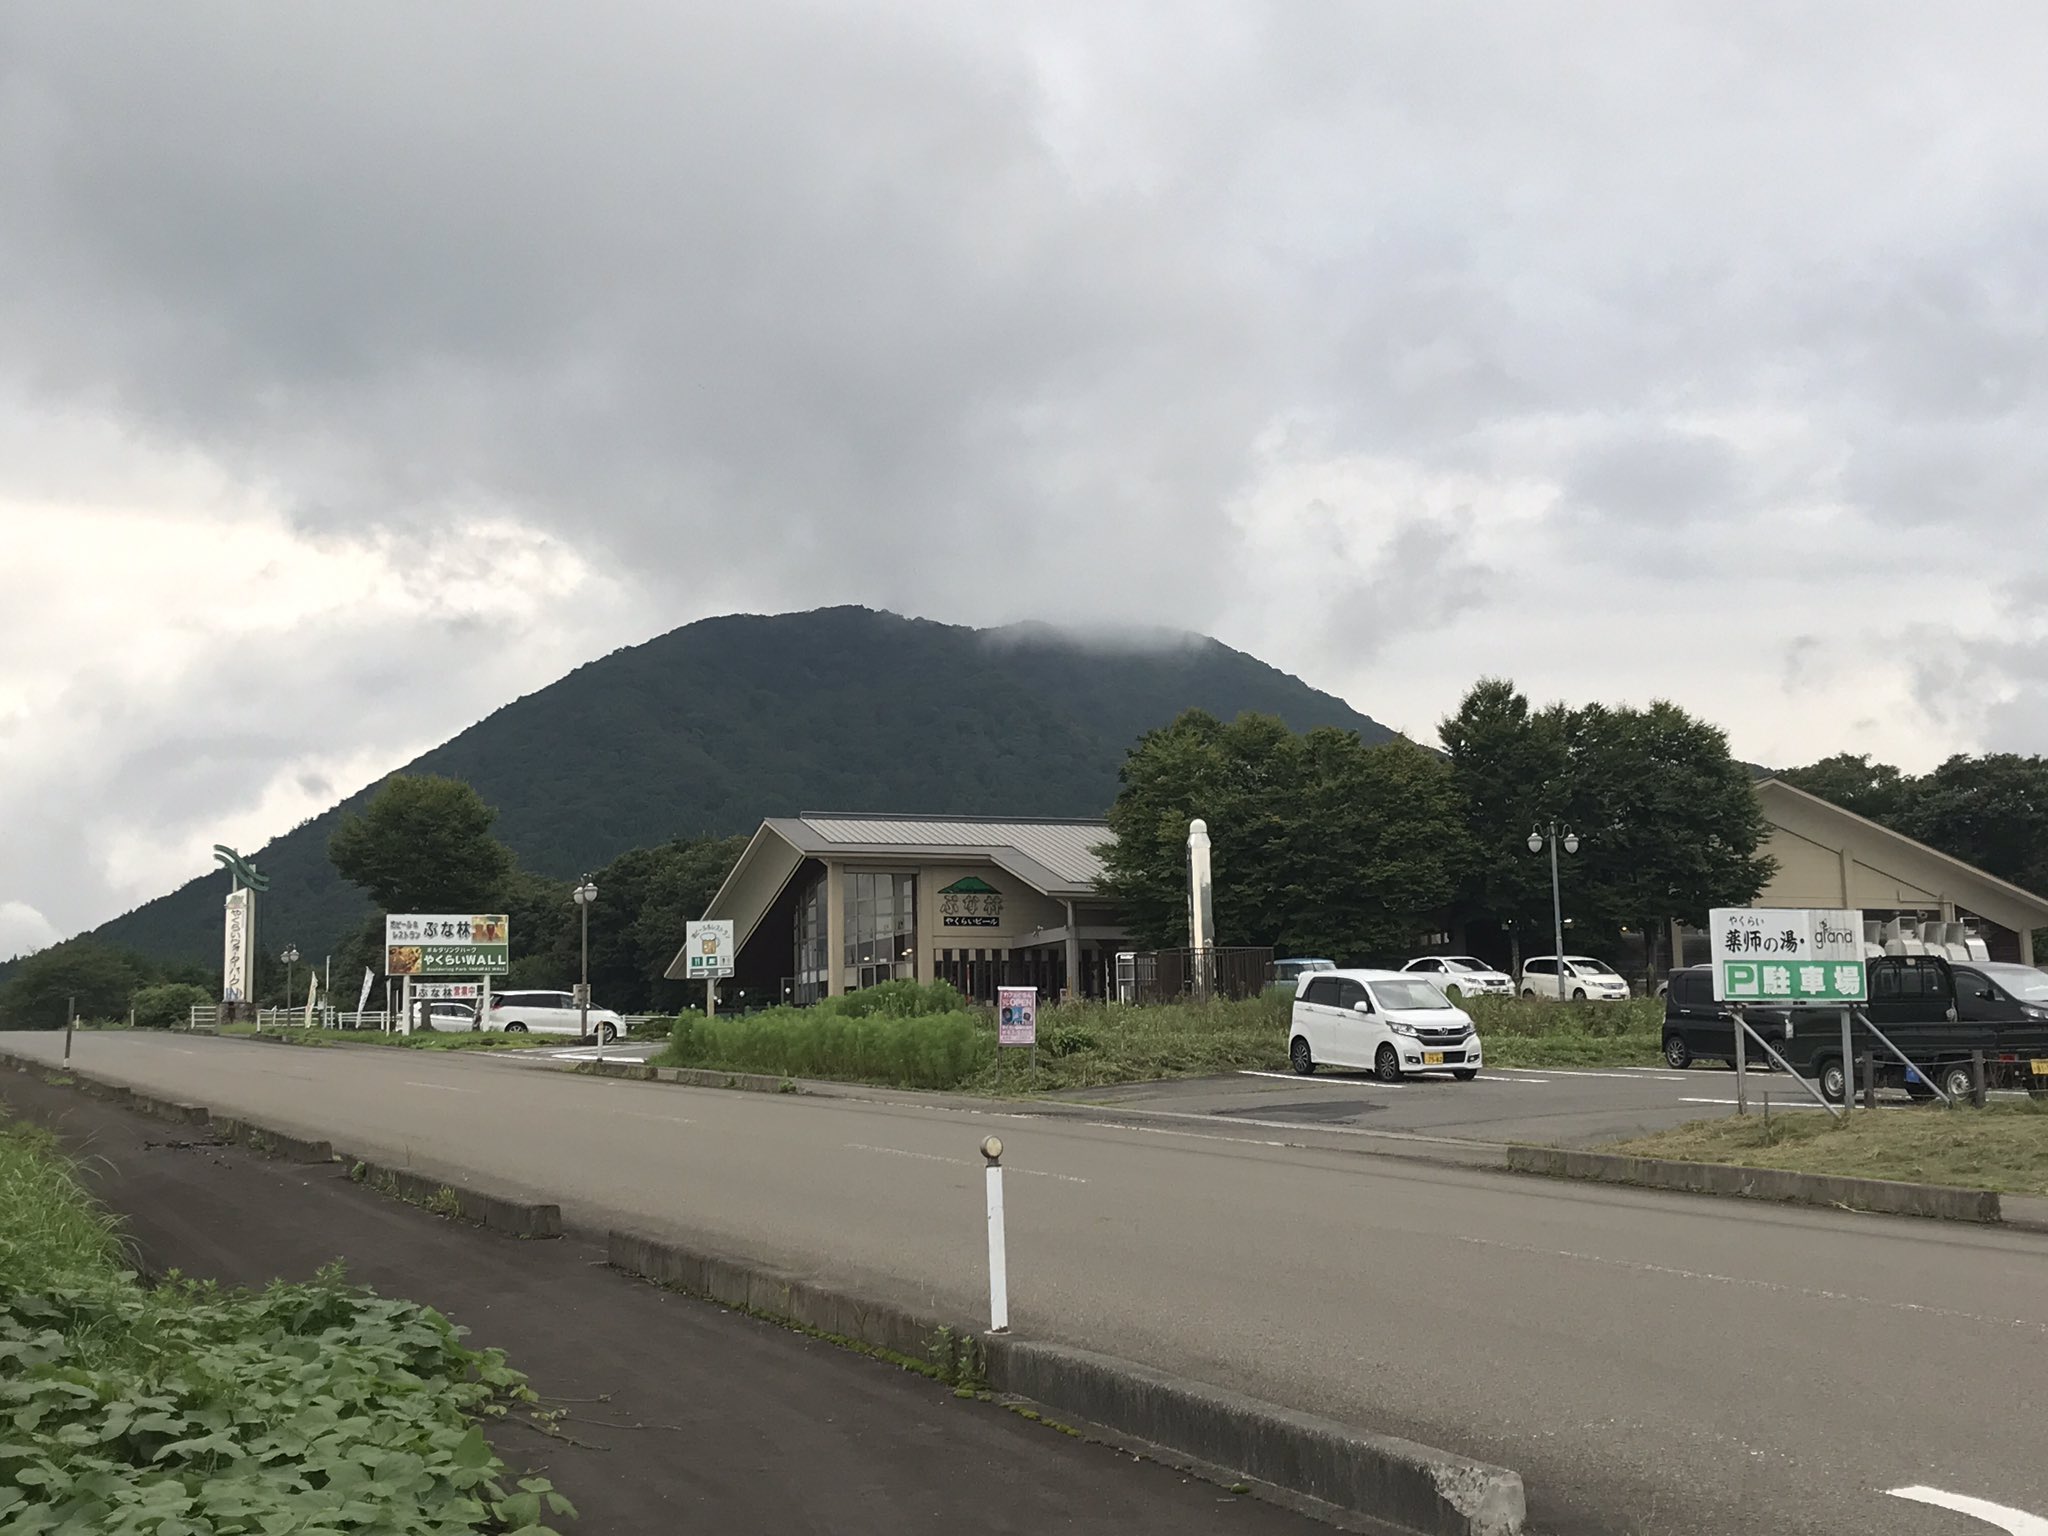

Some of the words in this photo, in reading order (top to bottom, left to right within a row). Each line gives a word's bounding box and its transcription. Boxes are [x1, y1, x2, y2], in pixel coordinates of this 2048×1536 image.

[939, 894, 1004, 915] ぶな林
[423, 920, 472, 938] ぶな林
[945, 917, 998, 926] やくらいビール
[1728, 915, 1765, 926] やくらい
[1814, 925, 1853, 950] grand
[1728, 966, 1755, 993] P
[1762, 965, 1860, 995] 駐車場
[418, 987, 453, 997] ぶな林
